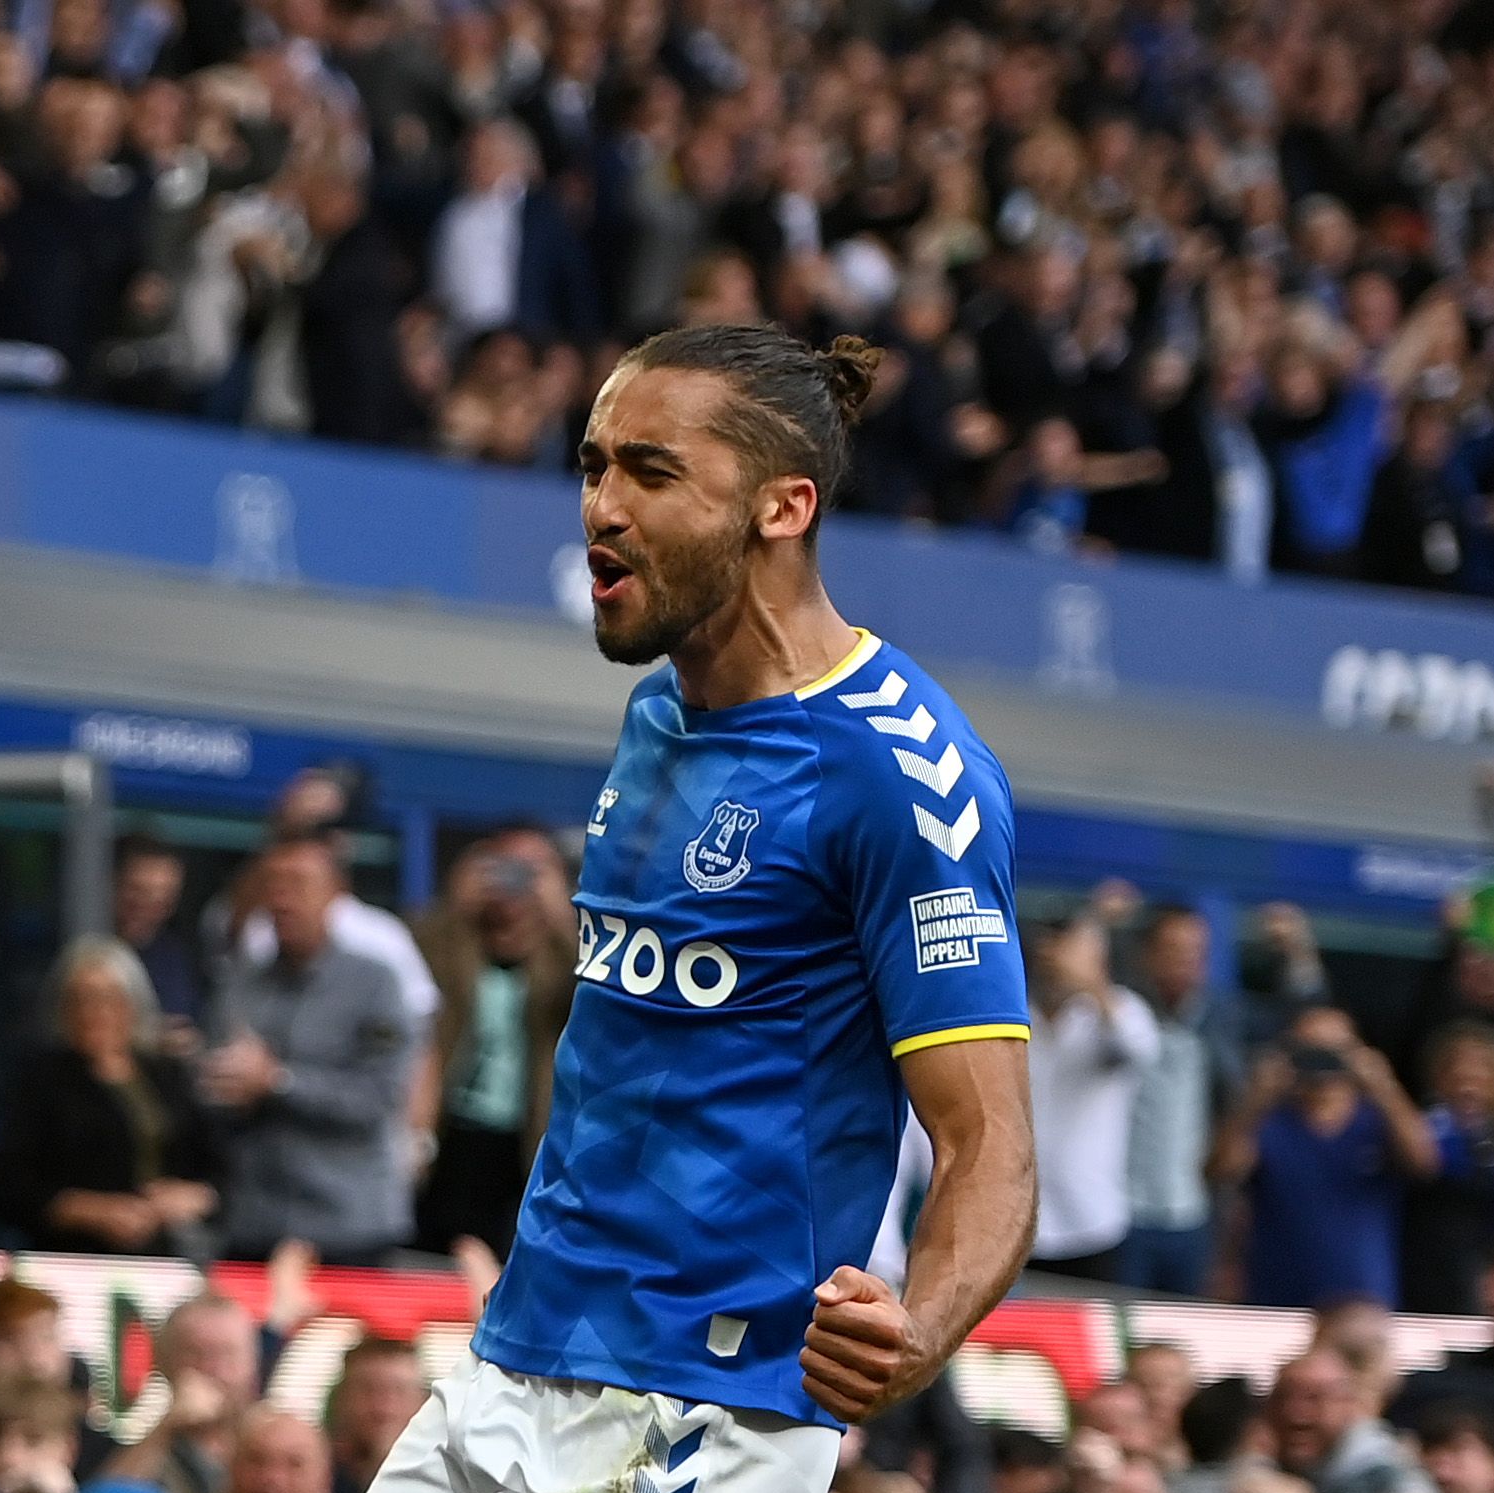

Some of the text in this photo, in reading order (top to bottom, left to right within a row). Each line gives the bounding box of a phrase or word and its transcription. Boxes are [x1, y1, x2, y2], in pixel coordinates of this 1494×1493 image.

[917, 894, 973, 921] UKRAINE
[920, 916, 1004, 943] HUMANITARIAN
[922, 939, 973, 965] APPEAL
